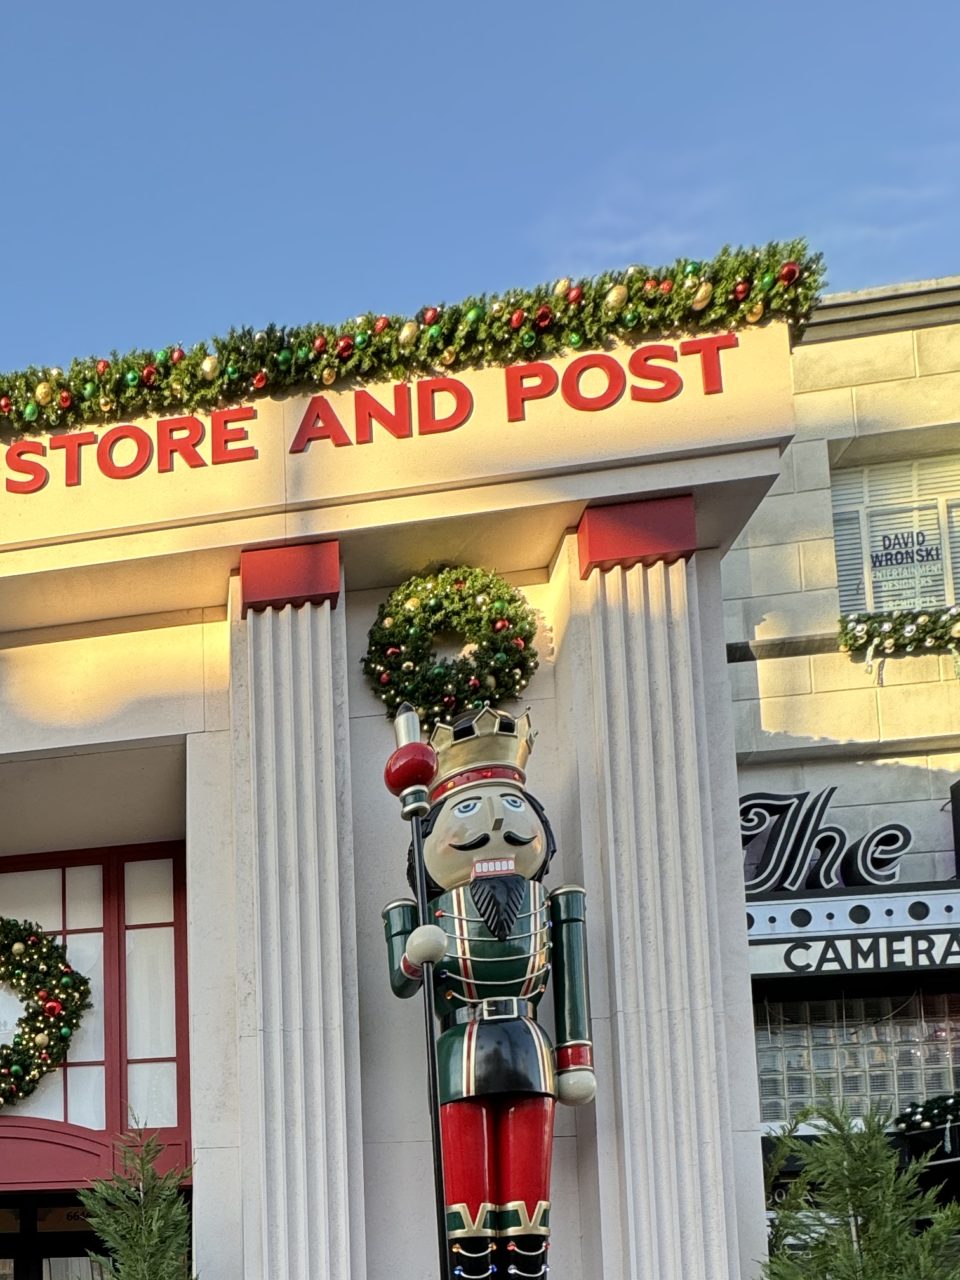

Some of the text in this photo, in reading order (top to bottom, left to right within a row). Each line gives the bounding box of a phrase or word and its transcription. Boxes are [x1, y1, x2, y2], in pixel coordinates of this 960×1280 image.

[5, 405, 258, 494] STORE
[288, 375, 473, 454] AND
[505, 333, 739, 423] POST
[871, 546, 942, 568] WRONSKI
[882, 531, 926, 550] DAVID
[739, 786, 912, 894] The
